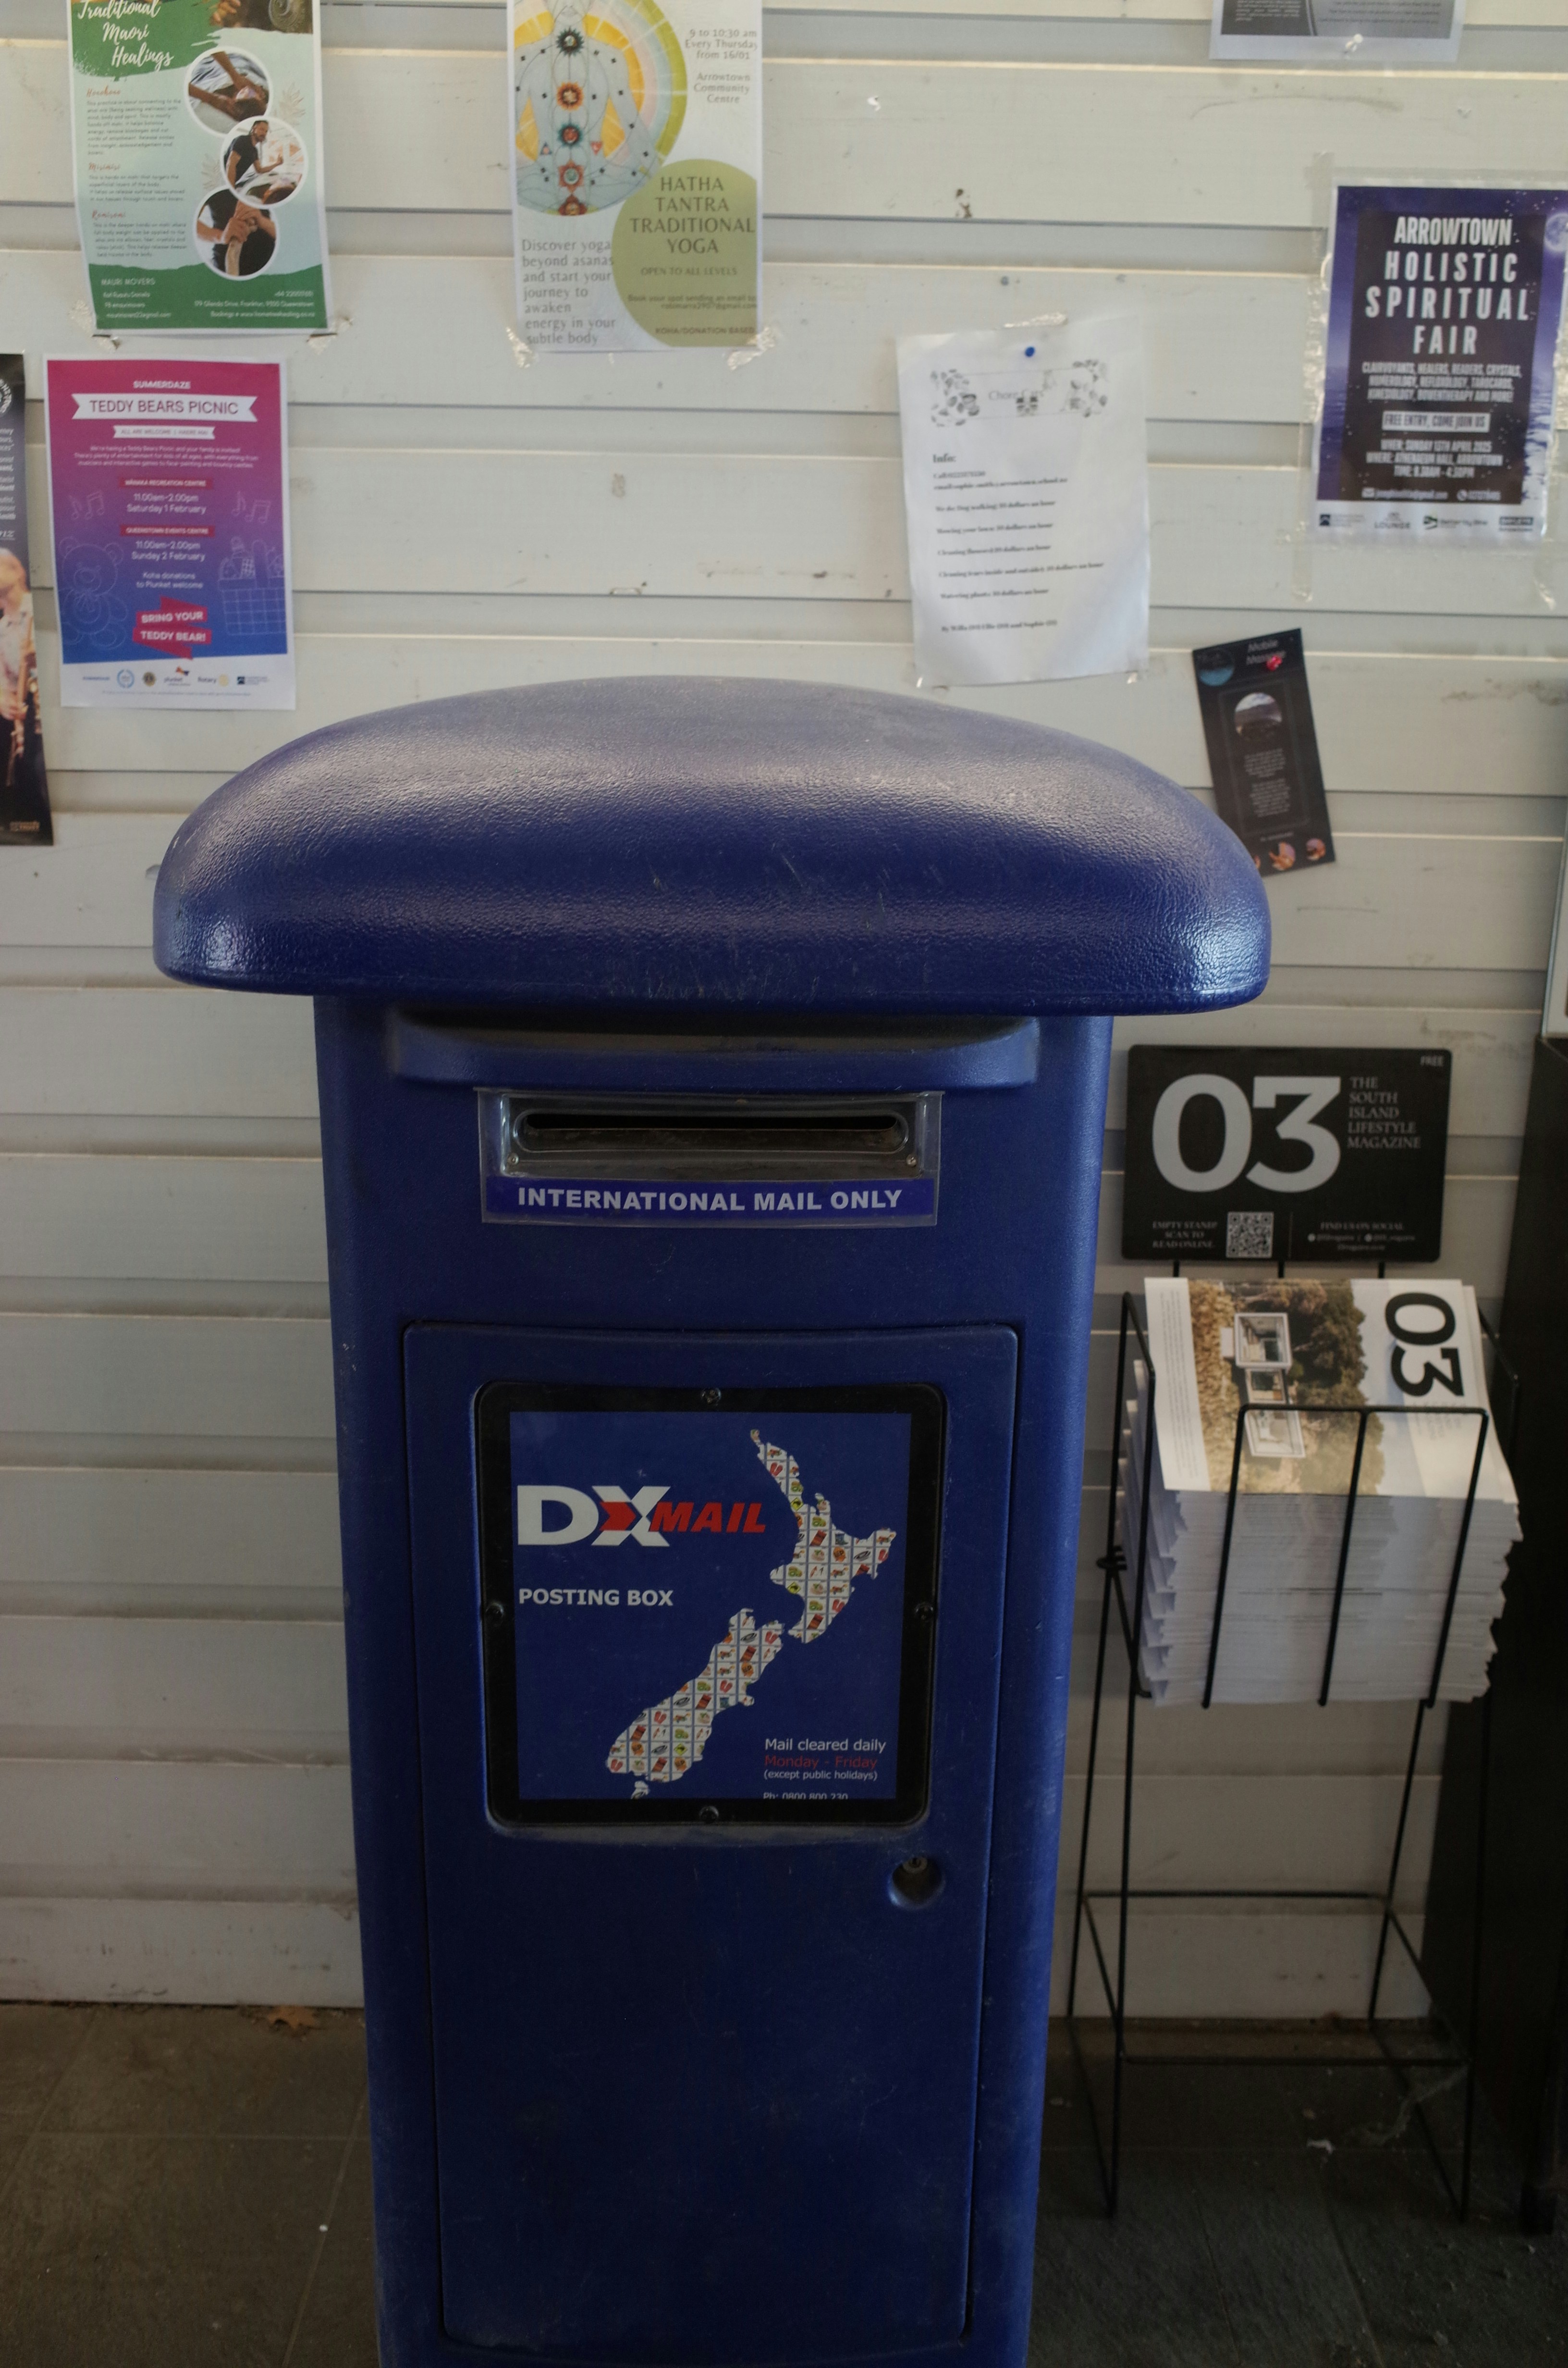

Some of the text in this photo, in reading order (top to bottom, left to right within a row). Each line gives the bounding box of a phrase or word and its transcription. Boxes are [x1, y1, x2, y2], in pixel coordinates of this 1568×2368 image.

[78, 0, 160, 19] Traditional
[103, 22, 149, 45] Maori
[690, 29, 696, 38] 9
[713, 29, 739, 38] 10:30
[685, 39, 757, 50] Every Thursday
[111, 42, 174, 71] Healings
[697, 50, 750, 60] from 16/01
[697, 73, 751, 81] Arrowtown
[693, 83, 749, 95] Community
[707, 94, 740, 103] Centre
[661, 176, 724, 192] HATHA
[655, 197, 730, 212] TANTRA
[630, 218, 755, 234] TRADITIONAL
[1394, 217, 1512, 246] ARROWTOWN
[522, 239, 611, 254] Discover yoga
[667, 238, 719, 255] YOGA
[522, 255, 614, 269] beyond asanas
[1384, 251, 1518, 283] HOLISTIC
[523, 271, 612, 284] and start your
[641, 267, 737, 275] OPEN TO ALL LEVELS
[523, 288, 588, 302] journey to
[525, 302, 571, 313] awaken
[1365, 286, 1529, 321] SPIRITUAL
[526, 317, 616, 332] energy in your
[527, 332, 597, 346] subtle body
[1413, 325, 1478, 355] FAIR
[133, 381, 190, 390] SUMMERDAZE
[90, 400, 238, 415] TEDDY BEARS PICNIC
[1384, 414, 1485, 429] FREE ENTRY, COME JOIN US
[933, 453, 956, 463] Info:
[127, 504, 163, 514] Saturday
[169, 505, 207, 515] February
[132, 551, 160, 561] Sunday
[169, 552, 206, 562] February
[141, 612, 203, 624] BRING YOUR
[141, 630, 206, 642] TEDDY BEAR!
[1349, 1075, 1379, 1090] THE
[1348, 1091, 1398, 1105] SOUTH
[1348, 1106, 1400, 1119] ISLAND
[1152, 1073, 1341, 1193] 03
[1347, 1121, 1416, 1134] LIFESTYLE
[1347, 1136, 1421, 1149] MAGAZINE
[518, 1187, 903, 1212] INTERNATIONAL MAIL ONLY
[1152, 1221, 1184, 1230] EMPTY
[1321, 1222, 1342, 1231] FIND
[1371, 1222, 1404, 1231] SOCIAL
[1164, 1231, 1205, 1239] SCAN TO
[1152, 1241, 1177, 1249] READ
[1384, 1292, 1465, 1397] 03
[517, 1485, 767, 1547] DX MAIL
[518, 1588, 674, 1606] POSTING BOX
[765, 1737, 887, 1754] Mail cleared daily
[764, 1755, 820, 1770] Monday
[835, 1755, 878, 1771] Friday
[763, 1768, 878, 1782] (except public holidays)
